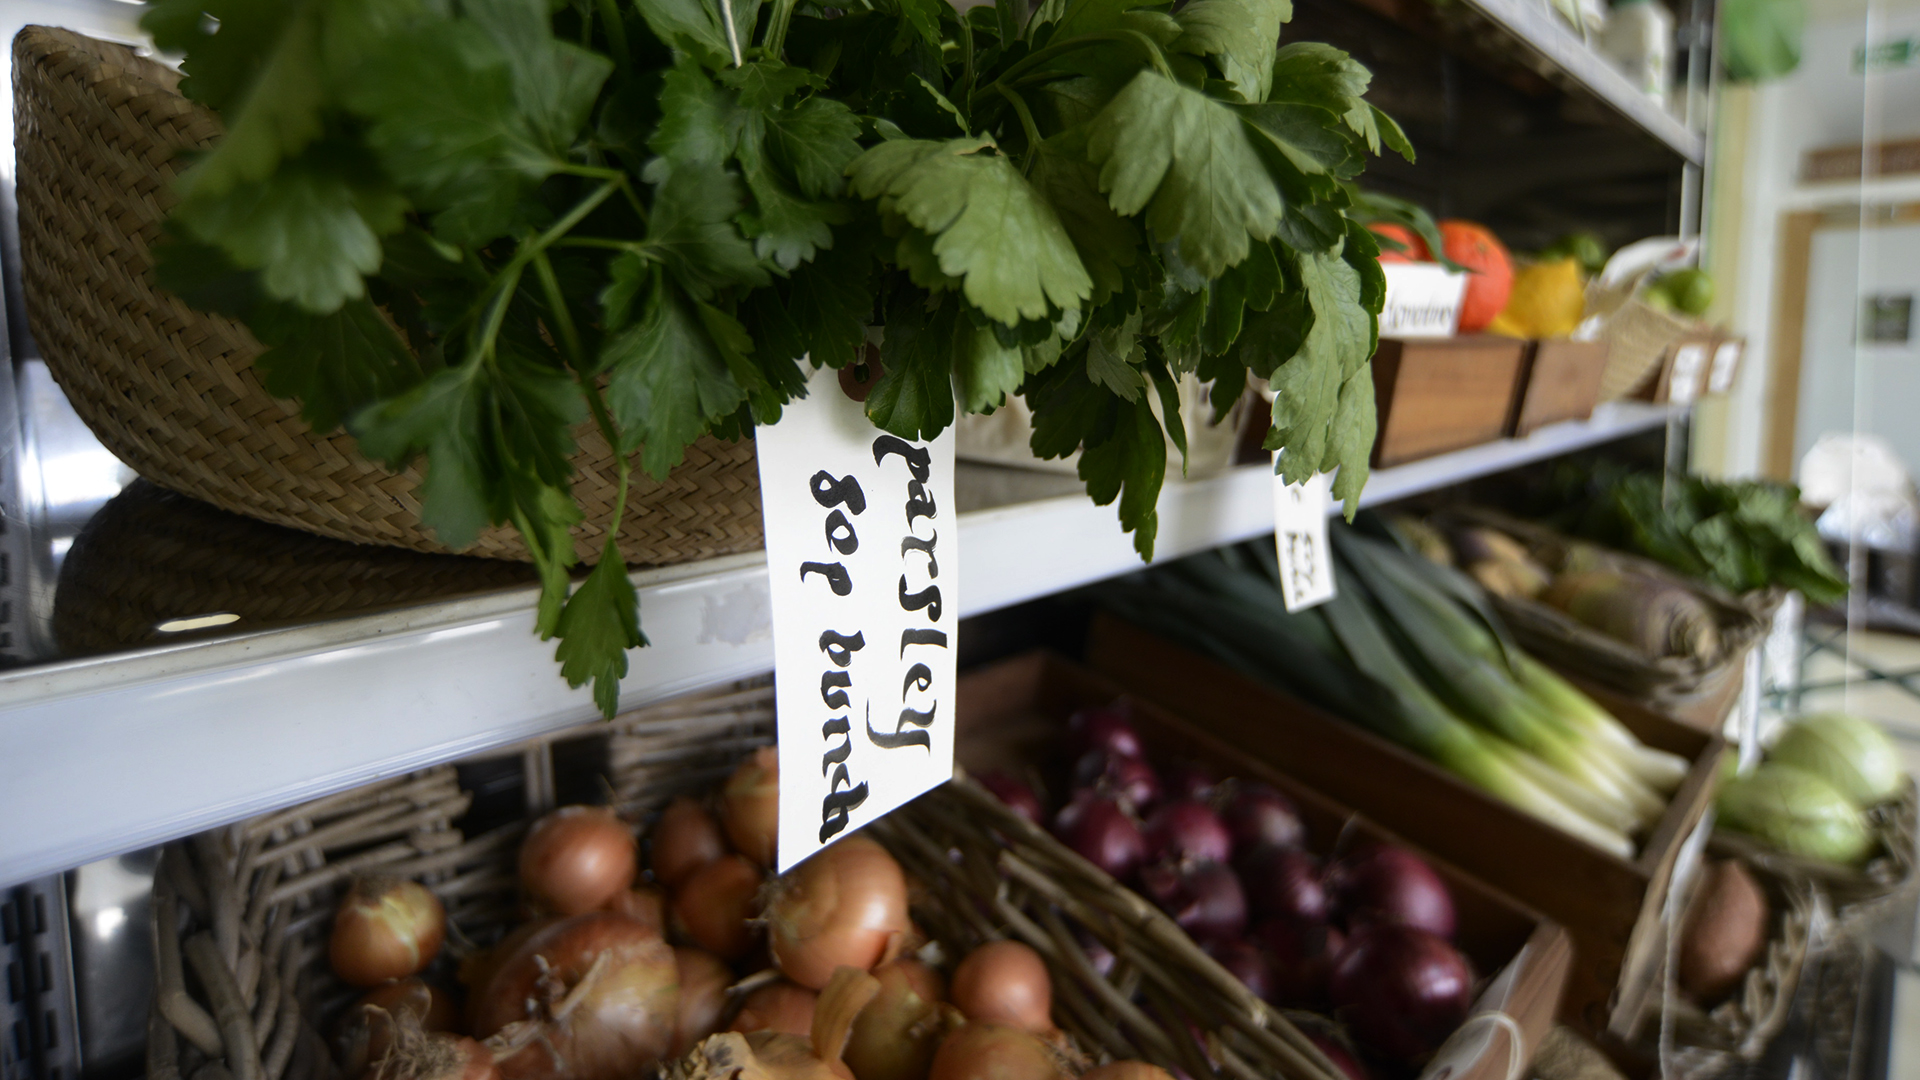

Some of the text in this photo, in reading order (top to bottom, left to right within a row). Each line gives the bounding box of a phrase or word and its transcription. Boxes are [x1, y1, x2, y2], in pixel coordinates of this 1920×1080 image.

[800, 469, 869, 845] 80p bunch
[867, 434, 948, 756] parsley
